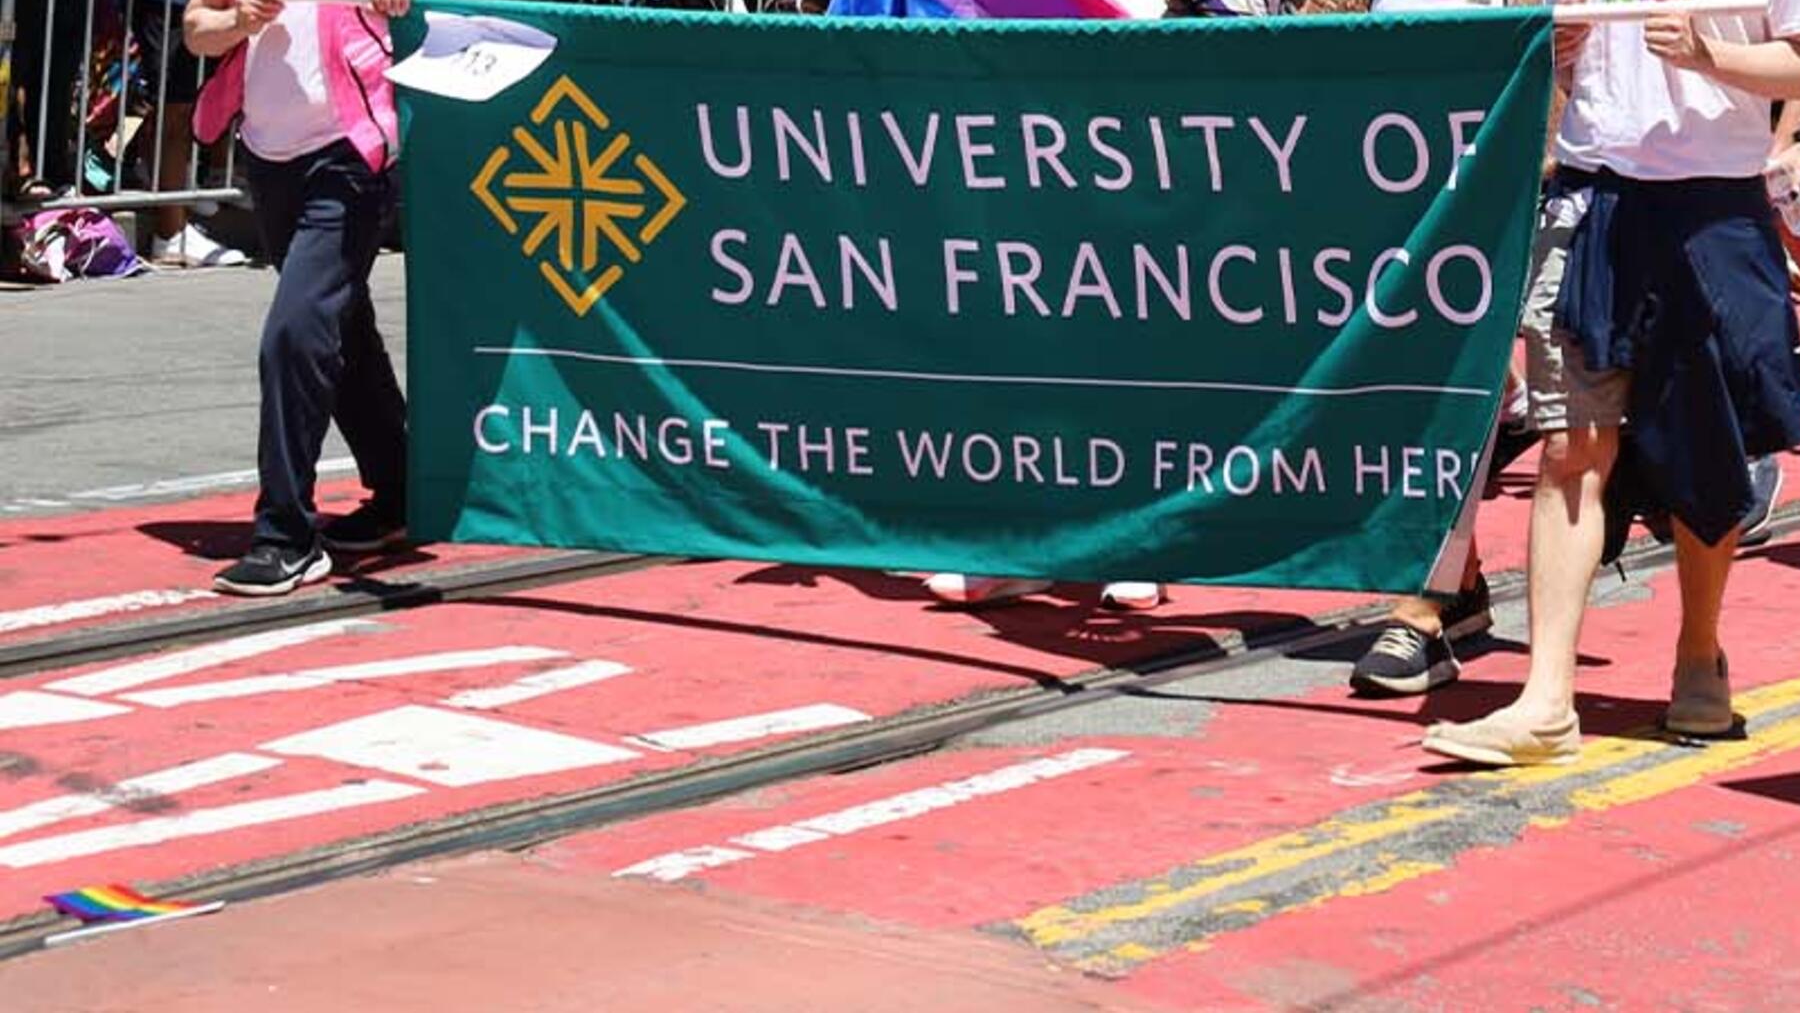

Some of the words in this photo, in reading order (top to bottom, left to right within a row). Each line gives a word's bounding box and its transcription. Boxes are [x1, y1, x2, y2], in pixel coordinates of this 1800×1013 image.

[697, 103, 1307, 193] UNIVERSITY
[1362, 109, 1486, 193] OF
[710, 228, 898, 311] SAN
[943, 237, 1493, 328] FRANCISCO
[472, 405, 731, 469] CHANGE
[757, 421, 874, 476] THE
[897, 430, 1126, 487] WORLD
[1153, 440, 1327, 496] FROM
[1353, 444, 1479, 502] HER
